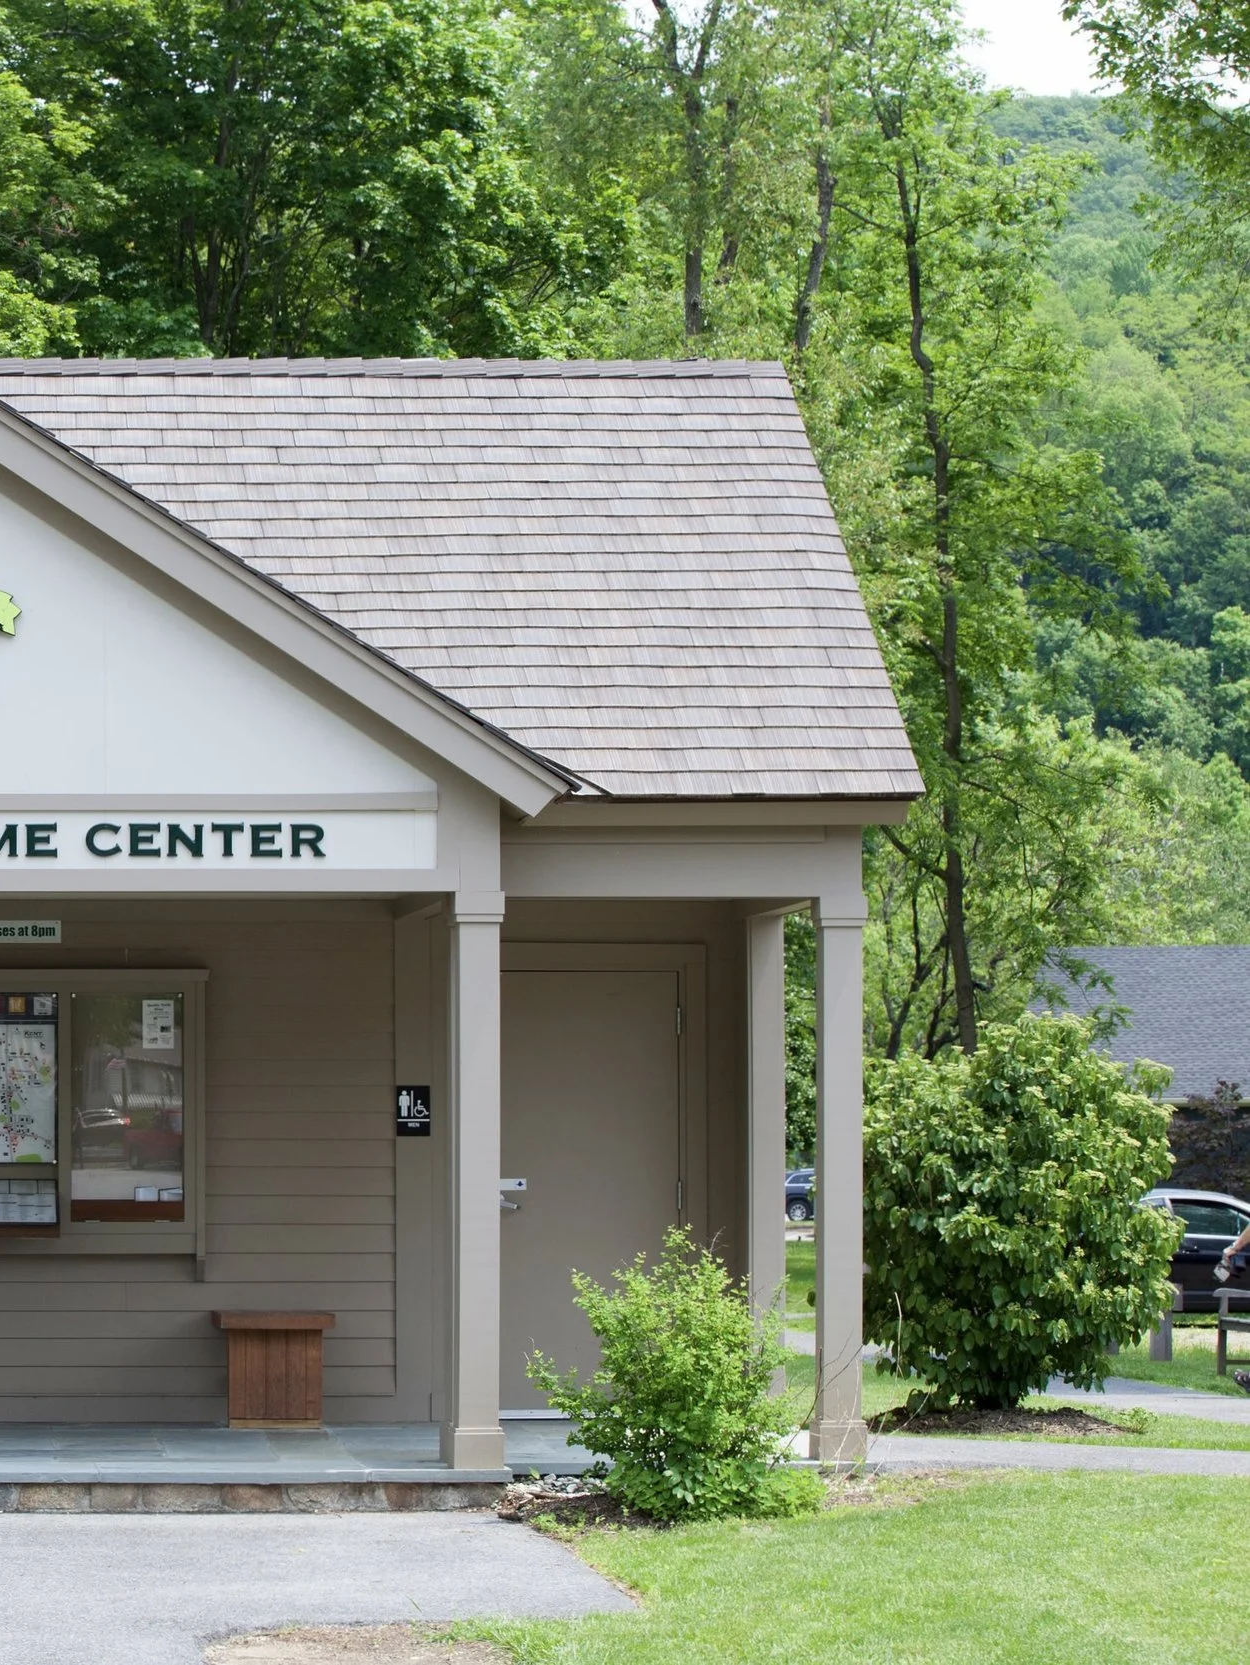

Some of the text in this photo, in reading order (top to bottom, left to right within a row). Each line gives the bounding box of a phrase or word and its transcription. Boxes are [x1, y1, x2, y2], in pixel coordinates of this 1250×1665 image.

[85, 821, 327, 858] CENTER
[18, 926, 29, 936] at
[31, 925, 56, 937] 8pm
